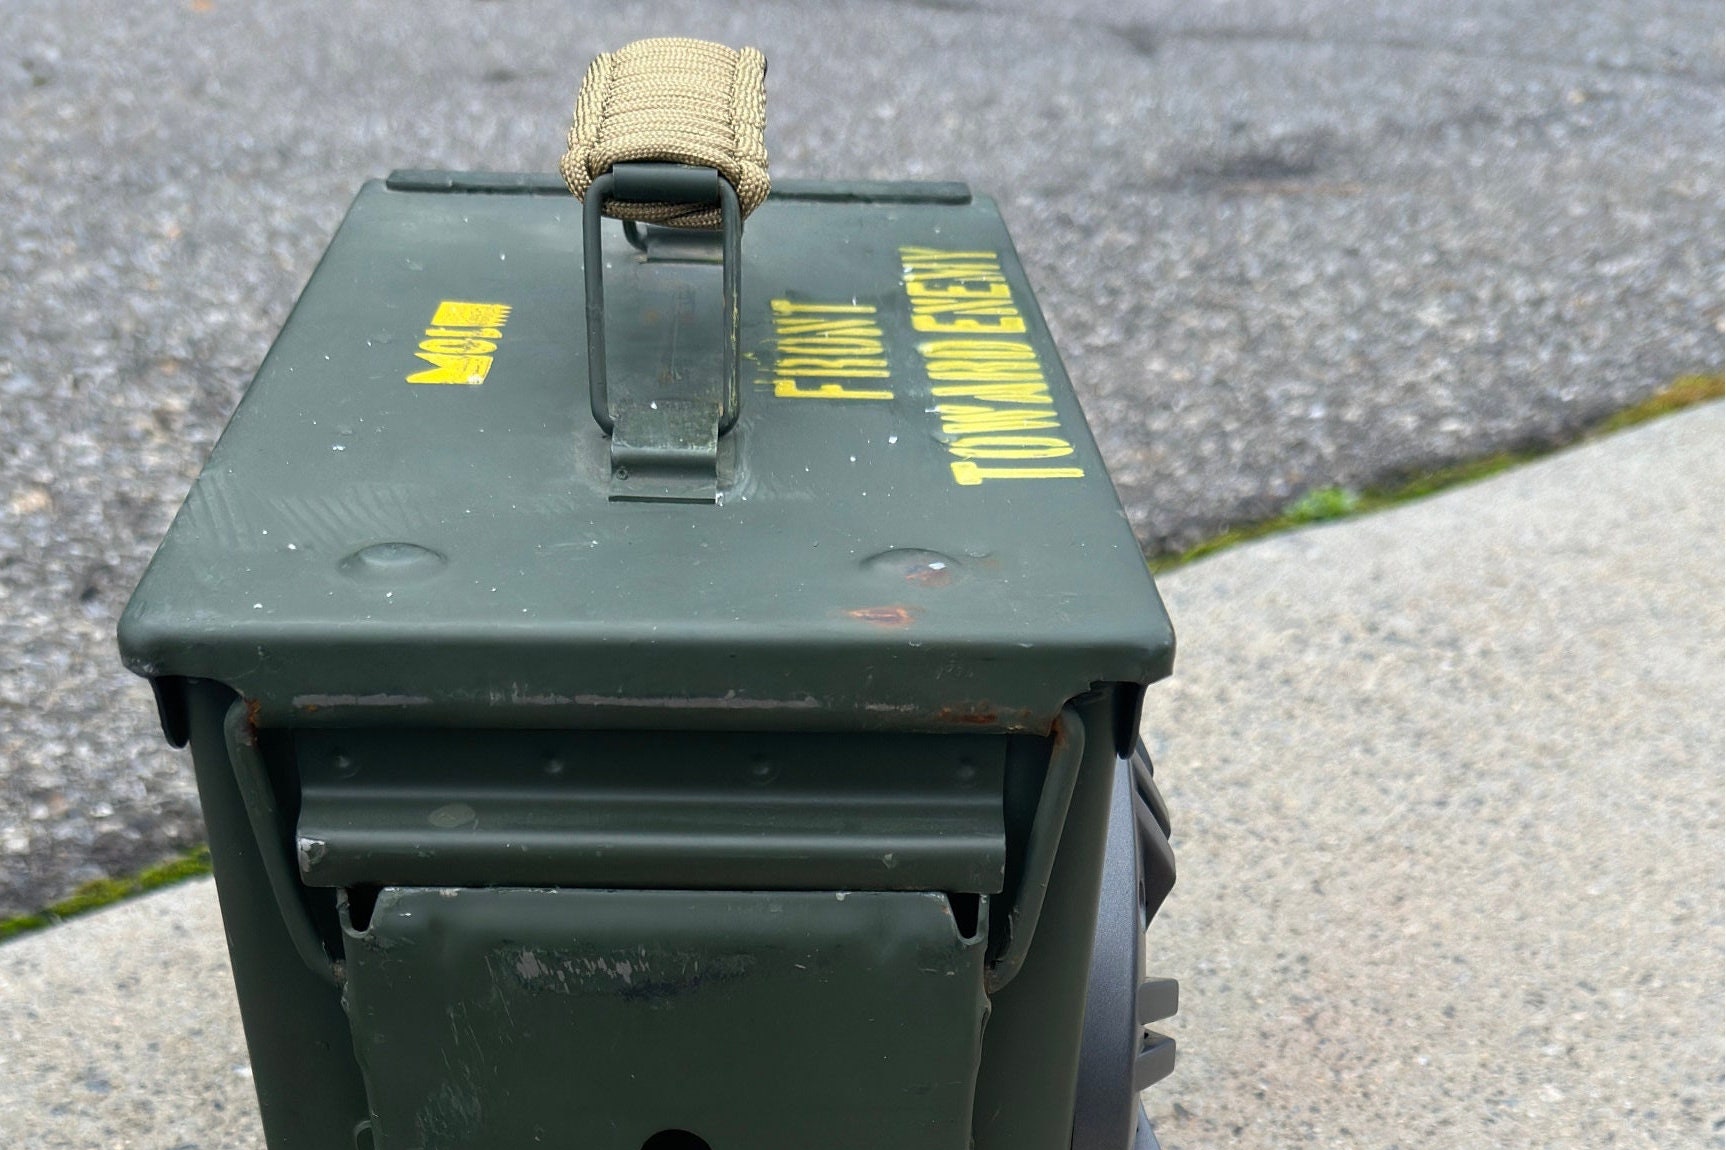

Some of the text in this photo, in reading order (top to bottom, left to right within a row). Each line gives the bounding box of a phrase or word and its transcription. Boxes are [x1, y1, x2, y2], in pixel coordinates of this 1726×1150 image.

[770, 299, 894, 399] FRONT
[898, 247, 1085, 485] TOWARD ENEMY
